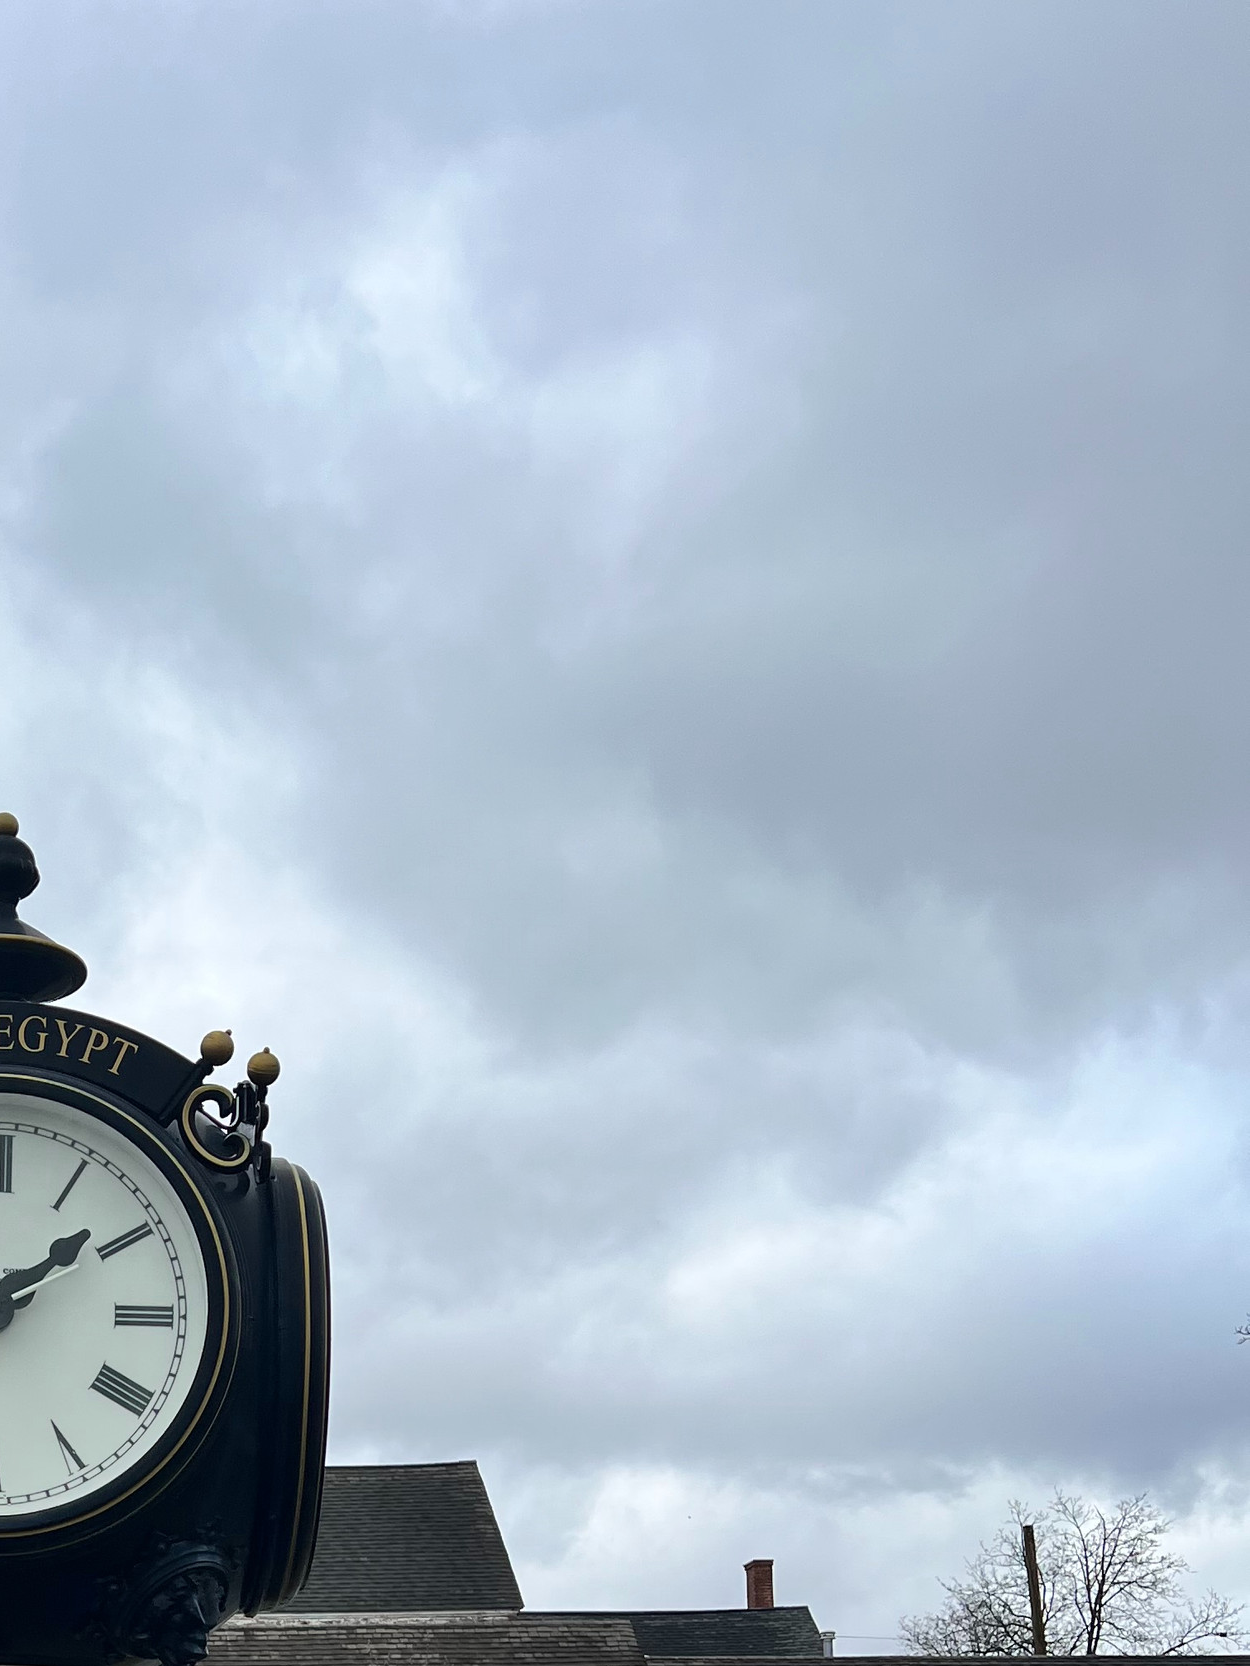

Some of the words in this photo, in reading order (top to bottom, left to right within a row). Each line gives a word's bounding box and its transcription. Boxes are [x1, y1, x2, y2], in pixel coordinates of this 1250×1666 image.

[50, 1159, 90, 1213] I
[95, 1219, 154, 1263] II
[113, 1302, 175, 1330] III
[88, 1361, 156, 1420] IIII
[50, 1418, 90, 1475] V
